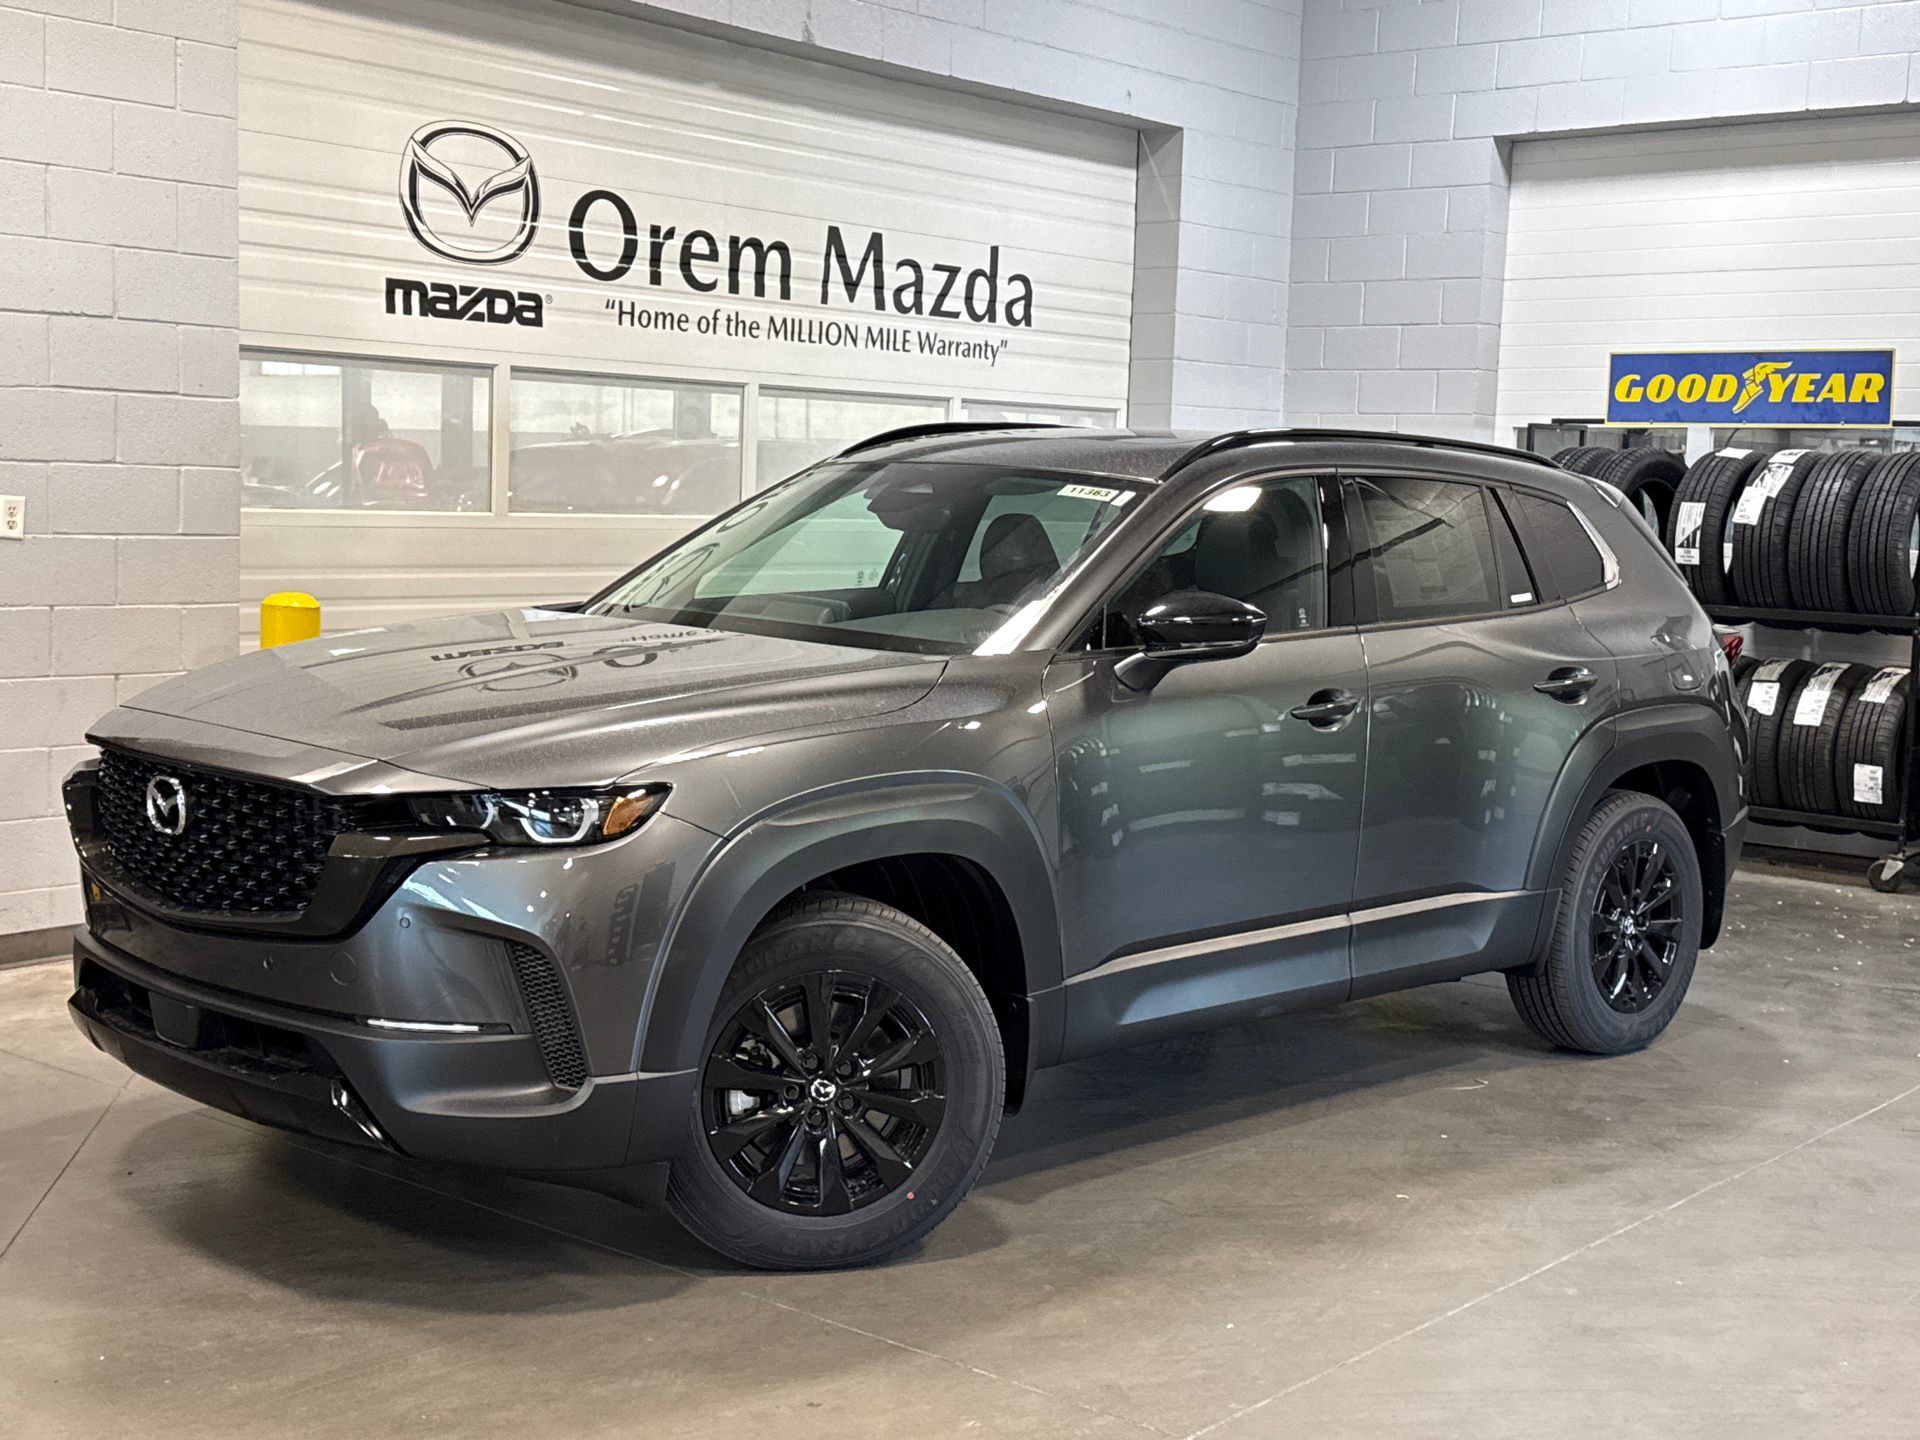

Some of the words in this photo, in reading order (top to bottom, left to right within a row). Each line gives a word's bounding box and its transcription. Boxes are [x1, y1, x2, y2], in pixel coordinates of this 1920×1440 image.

[568, 189, 792, 301] Orem
[820, 225, 1033, 328] Mazda
[697, 308, 722, 336] of
[725, 310, 761, 339] the
[767, 315, 859, 348] MILLION
[865, 325, 912, 353] MILE
